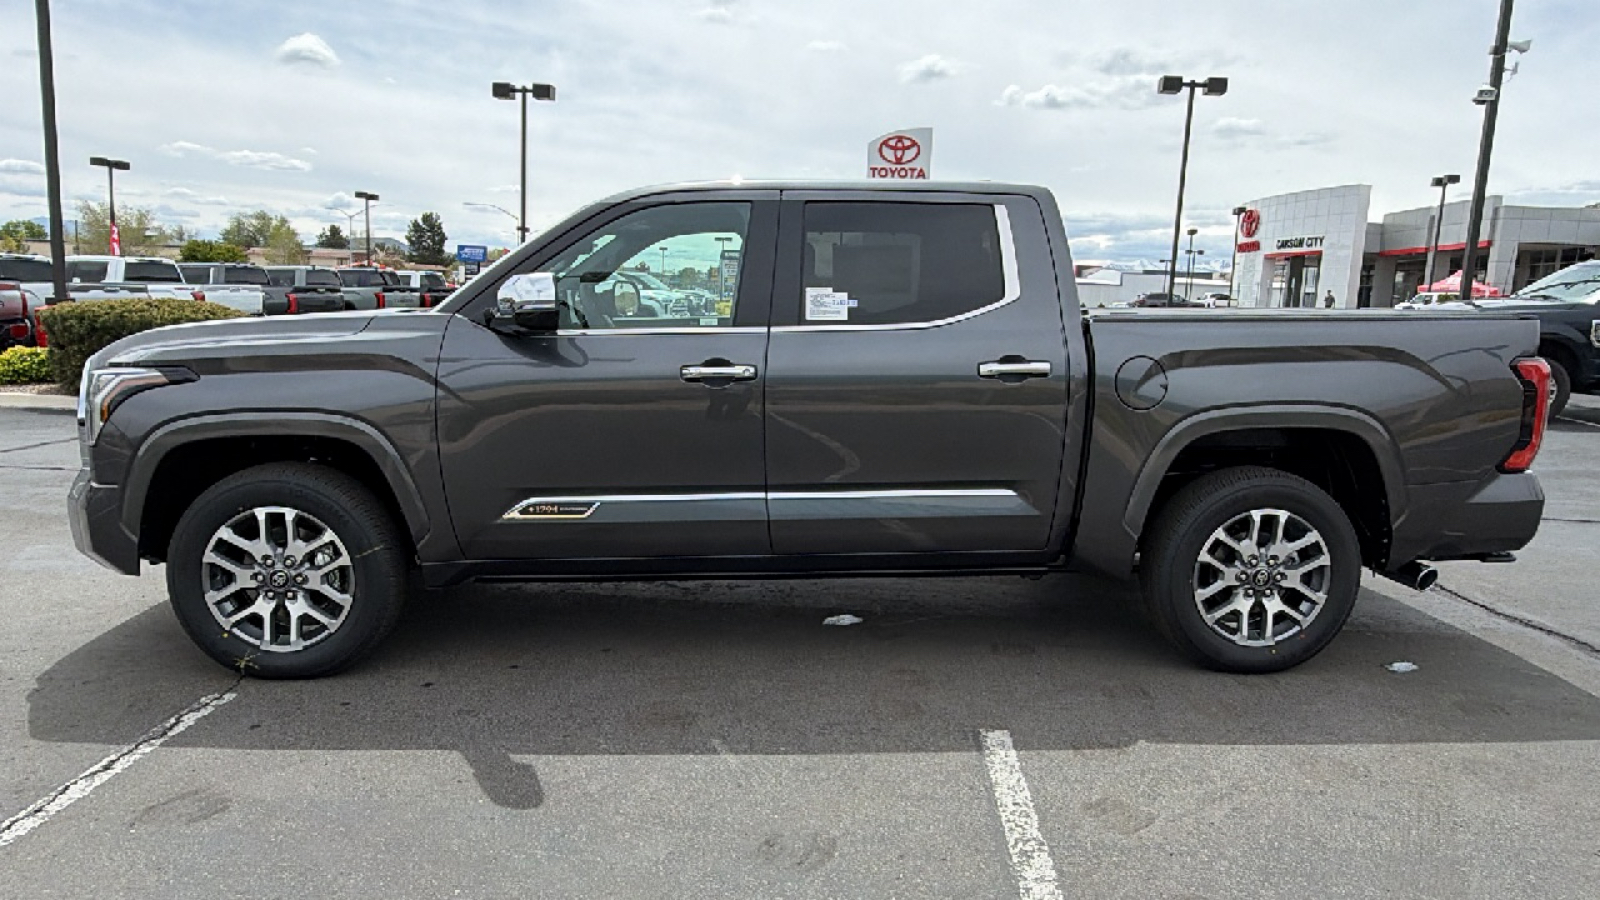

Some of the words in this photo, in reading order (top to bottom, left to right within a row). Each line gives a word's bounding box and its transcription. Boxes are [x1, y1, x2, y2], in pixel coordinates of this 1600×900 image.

[869, 167, 926, 180] TOYOTA
[1276, 237, 1305, 249] CARSON
[1306, 236, 1325, 247] CITY
[535, 505, 559, 513] 1794
